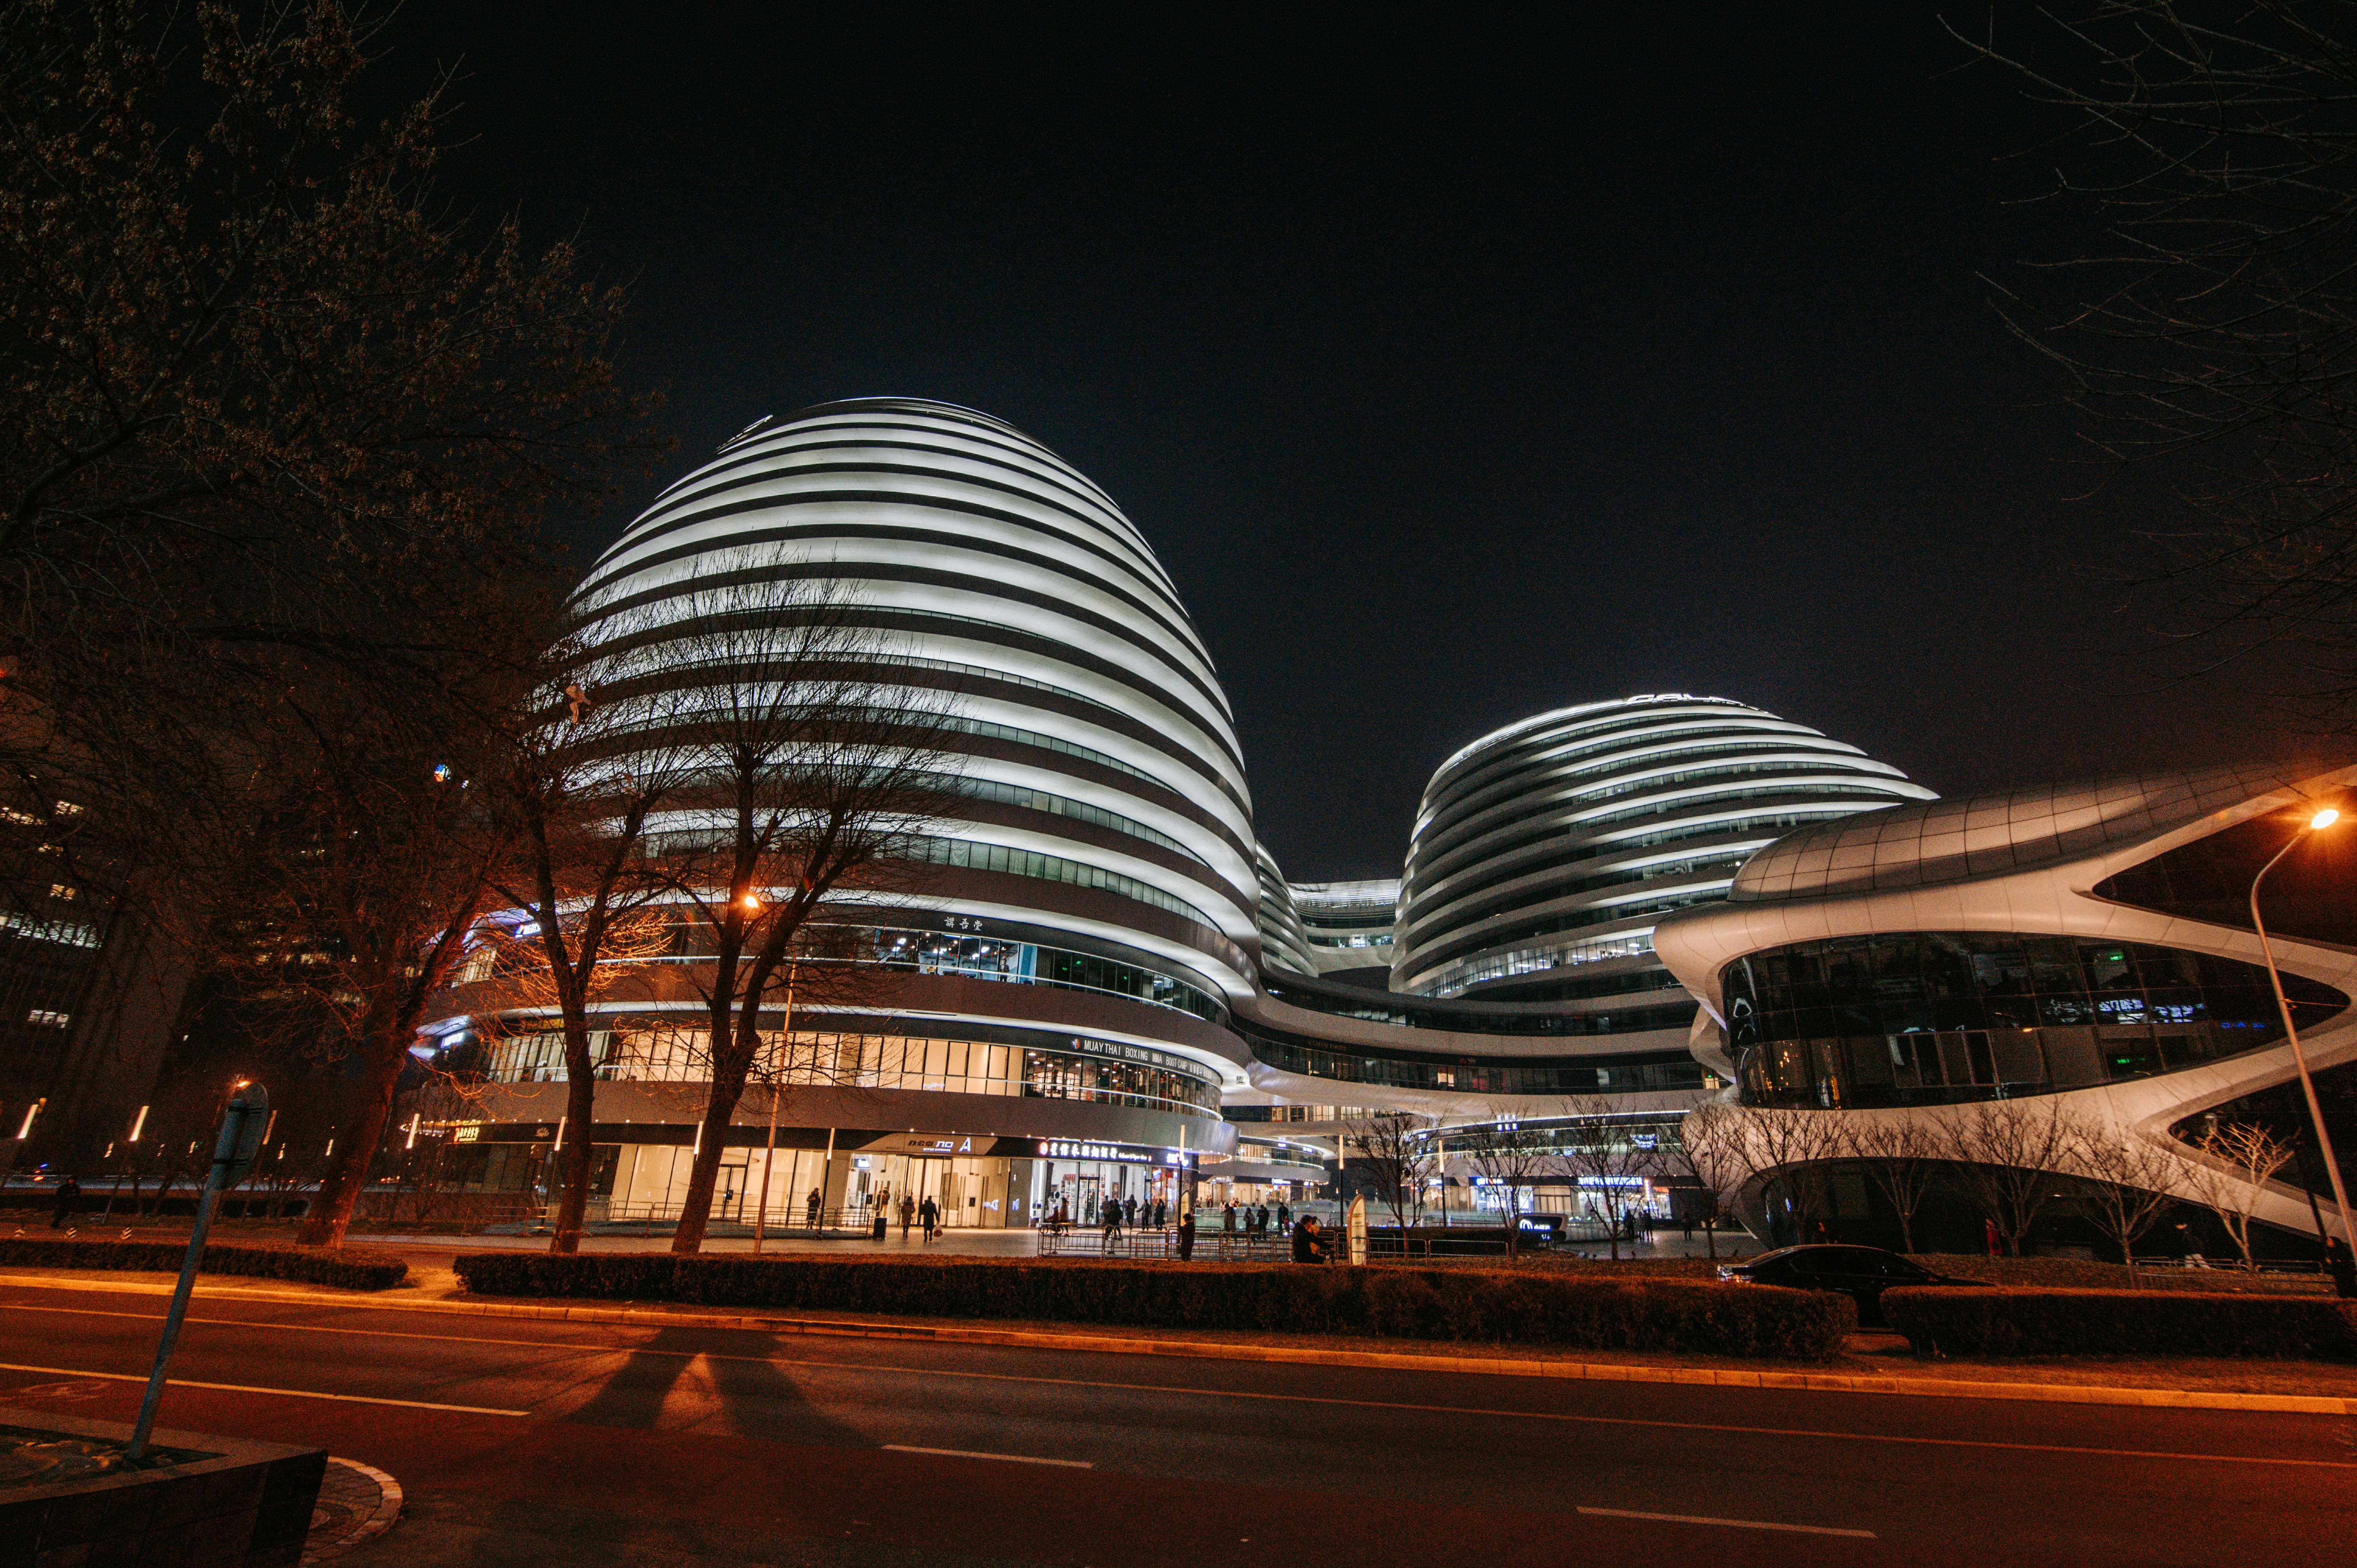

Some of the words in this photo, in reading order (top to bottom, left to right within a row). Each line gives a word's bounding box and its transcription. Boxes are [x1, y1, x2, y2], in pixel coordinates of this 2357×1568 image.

[1084, 1040, 1104, 1052] MUAY
[1104, 1043, 1121, 1056] THAI
[1125, 1047, 1148, 1061] BOXING
[1152, 1053, 1162, 1064] MMA
[1166, 1056, 1177, 1067] BOOT
[1178, 1059, 1187, 1070] CAMP
[959, 1137, 971, 1152] A
